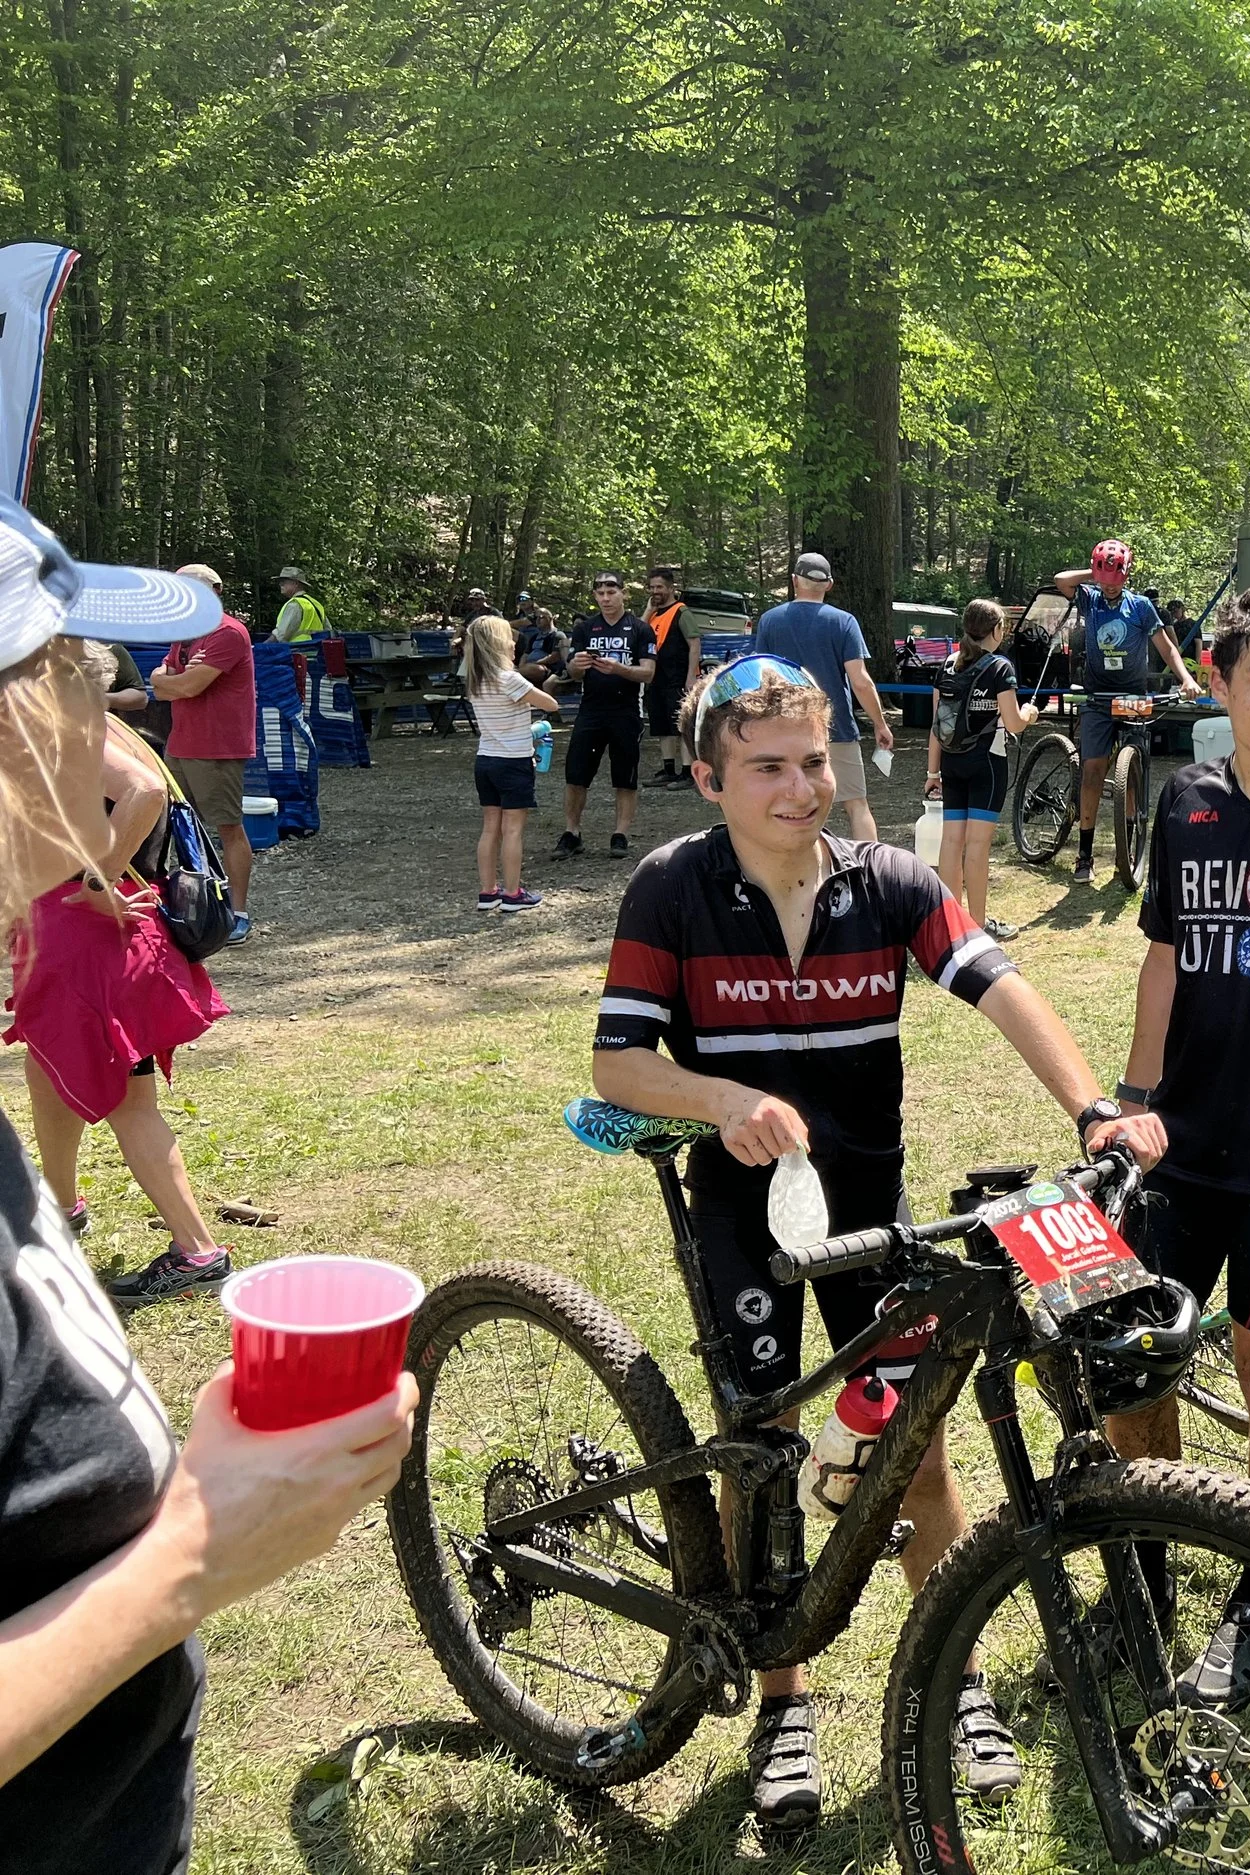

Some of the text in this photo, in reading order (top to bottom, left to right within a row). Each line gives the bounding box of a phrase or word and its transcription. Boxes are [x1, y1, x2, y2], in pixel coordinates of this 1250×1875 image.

[1117, 700, 1146, 711] 3013
[1188, 809, 1220, 824] NICA
[715, 969, 896, 1003] MOTOWN
[594, 1035, 627, 1044] CTIMO
[1019, 1201, 1108, 1257] 1003
[750, 1353, 786, 1372] PACTIMO
[903, 1686, 923, 1735] XR4
[901, 1744, 921, 1816] TEAM
